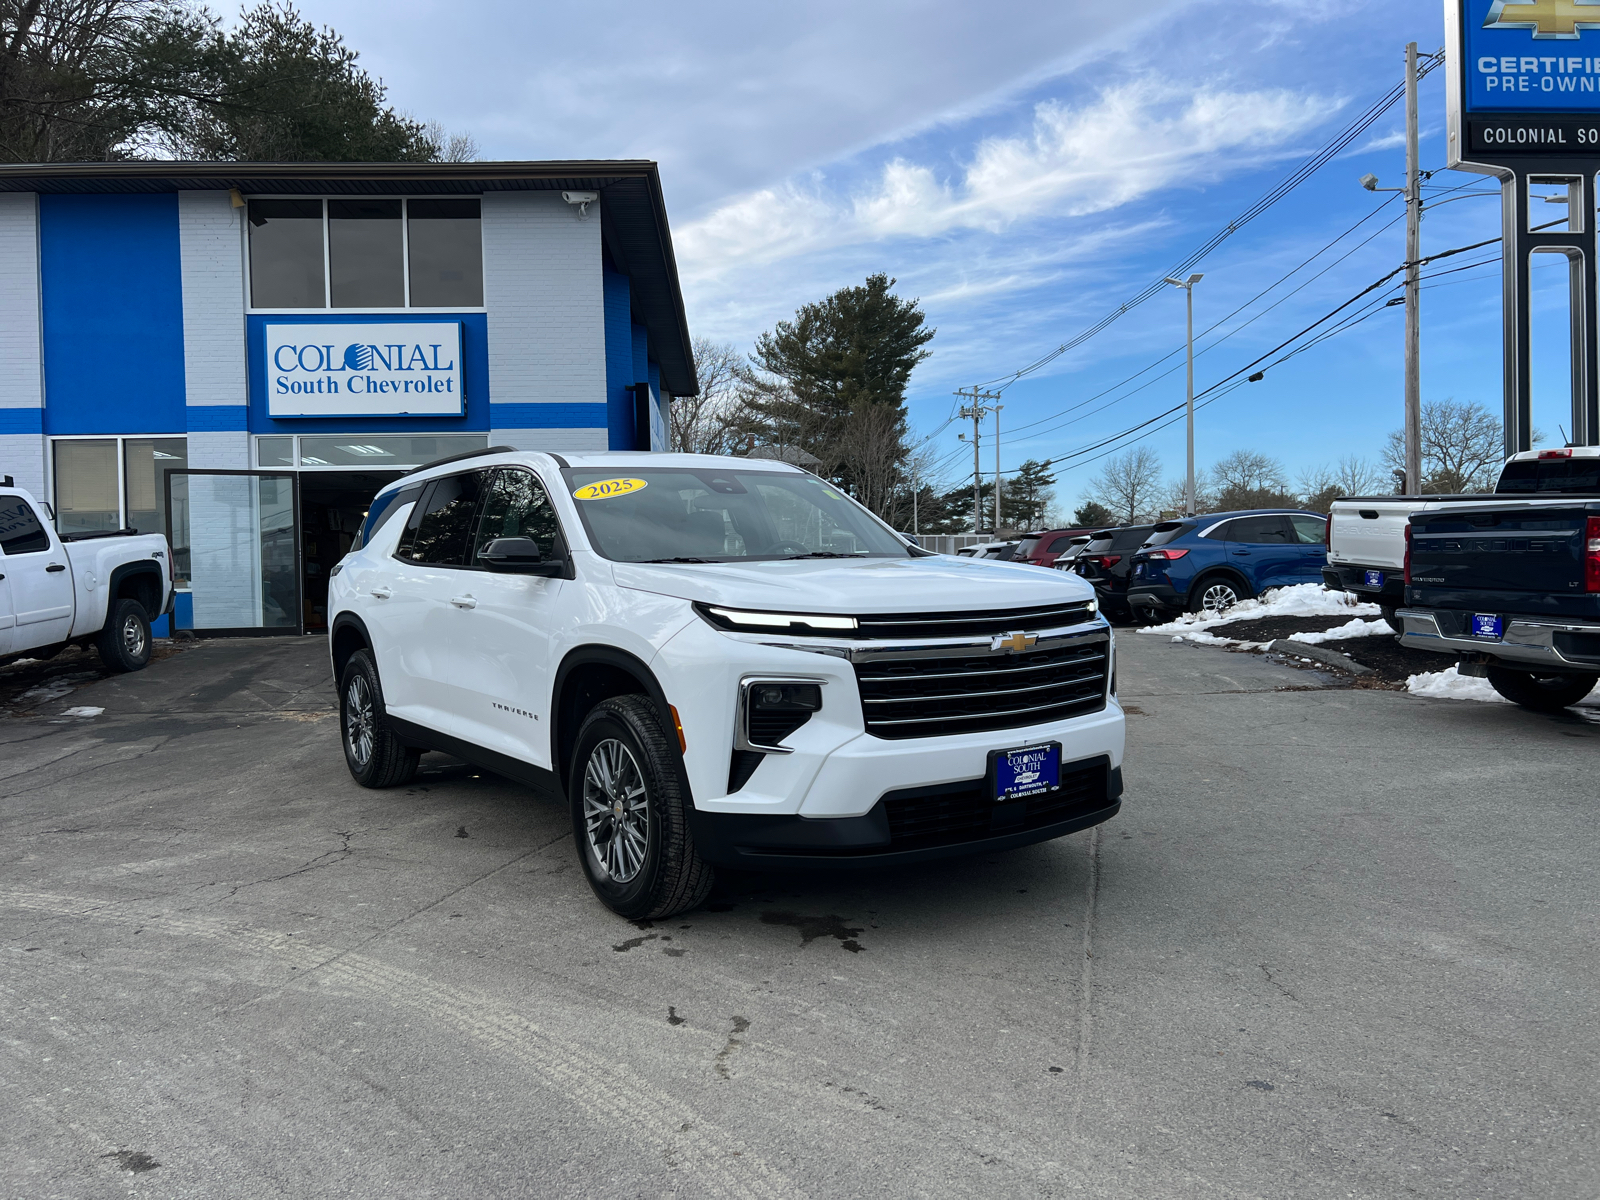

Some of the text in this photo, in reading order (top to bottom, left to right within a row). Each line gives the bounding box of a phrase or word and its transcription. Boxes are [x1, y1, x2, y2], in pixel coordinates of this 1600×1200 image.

[1486, 76, 1600, 92] PRE-OWN
[1484, 128, 1598, 144] COLONIAL SO
[274, 343, 453, 373] COLONIAL
[276, 375, 454, 395] South Chevrolet
[587, 479, 633, 498] 2025
[491, 701, 539, 721] TRAVERSE
[1008, 752, 1047, 766] COLONIAL
[1013, 761, 1041, 774] SOUTH
